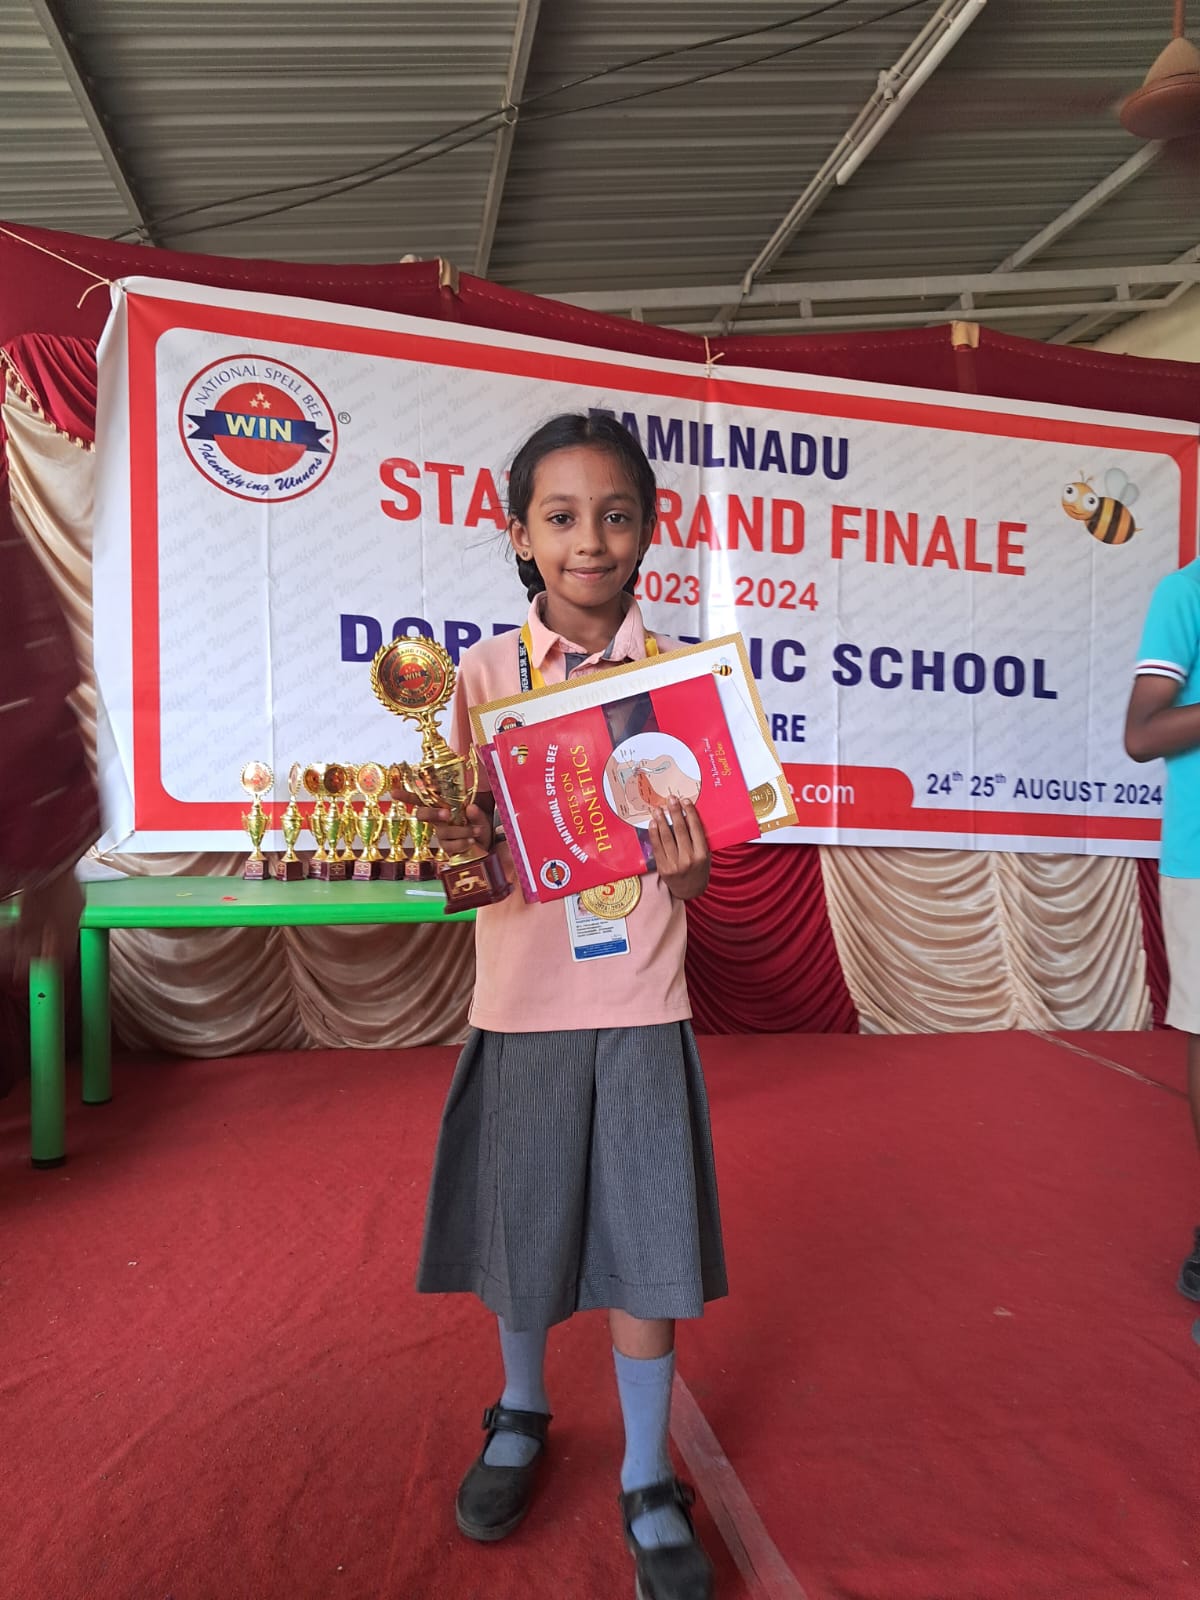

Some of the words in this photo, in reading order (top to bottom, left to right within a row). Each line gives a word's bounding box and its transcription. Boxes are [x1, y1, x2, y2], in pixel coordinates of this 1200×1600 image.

[194, 364, 260, 405] NATIONAL
[263, 366, 303, 395] SPELL
[301, 393, 323, 419] BEE
[225, 413, 292, 442] WIN
[198, 443, 271, 495] Identifying
[273, 457, 324, 491] Winners
[378, 457, 511, 531] STA
[650, 487, 806, 555] RAND
[830, 504, 1028, 576] FINALE
[734, 576, 819, 611] 2024
[832, 643, 1059, 699] SCHOOL
[546, 743, 559, 764] BEE
[717, 758, 733, 776] Spell
[544, 765, 556, 797] SPELL
[560, 772, 574, 793] ON
[570, 744, 612, 852] PHONETICS
[926, 770, 964, 795] 24th
[969, 773, 1007, 797] 25th
[1012, 777, 1107, 802] AUGUST
[1113, 783, 1163, 805] 2024
[548, 797, 574, 847] NATIONAL
[567, 795, 587, 836] NOTES
[569, 842, 589, 864] WIN
